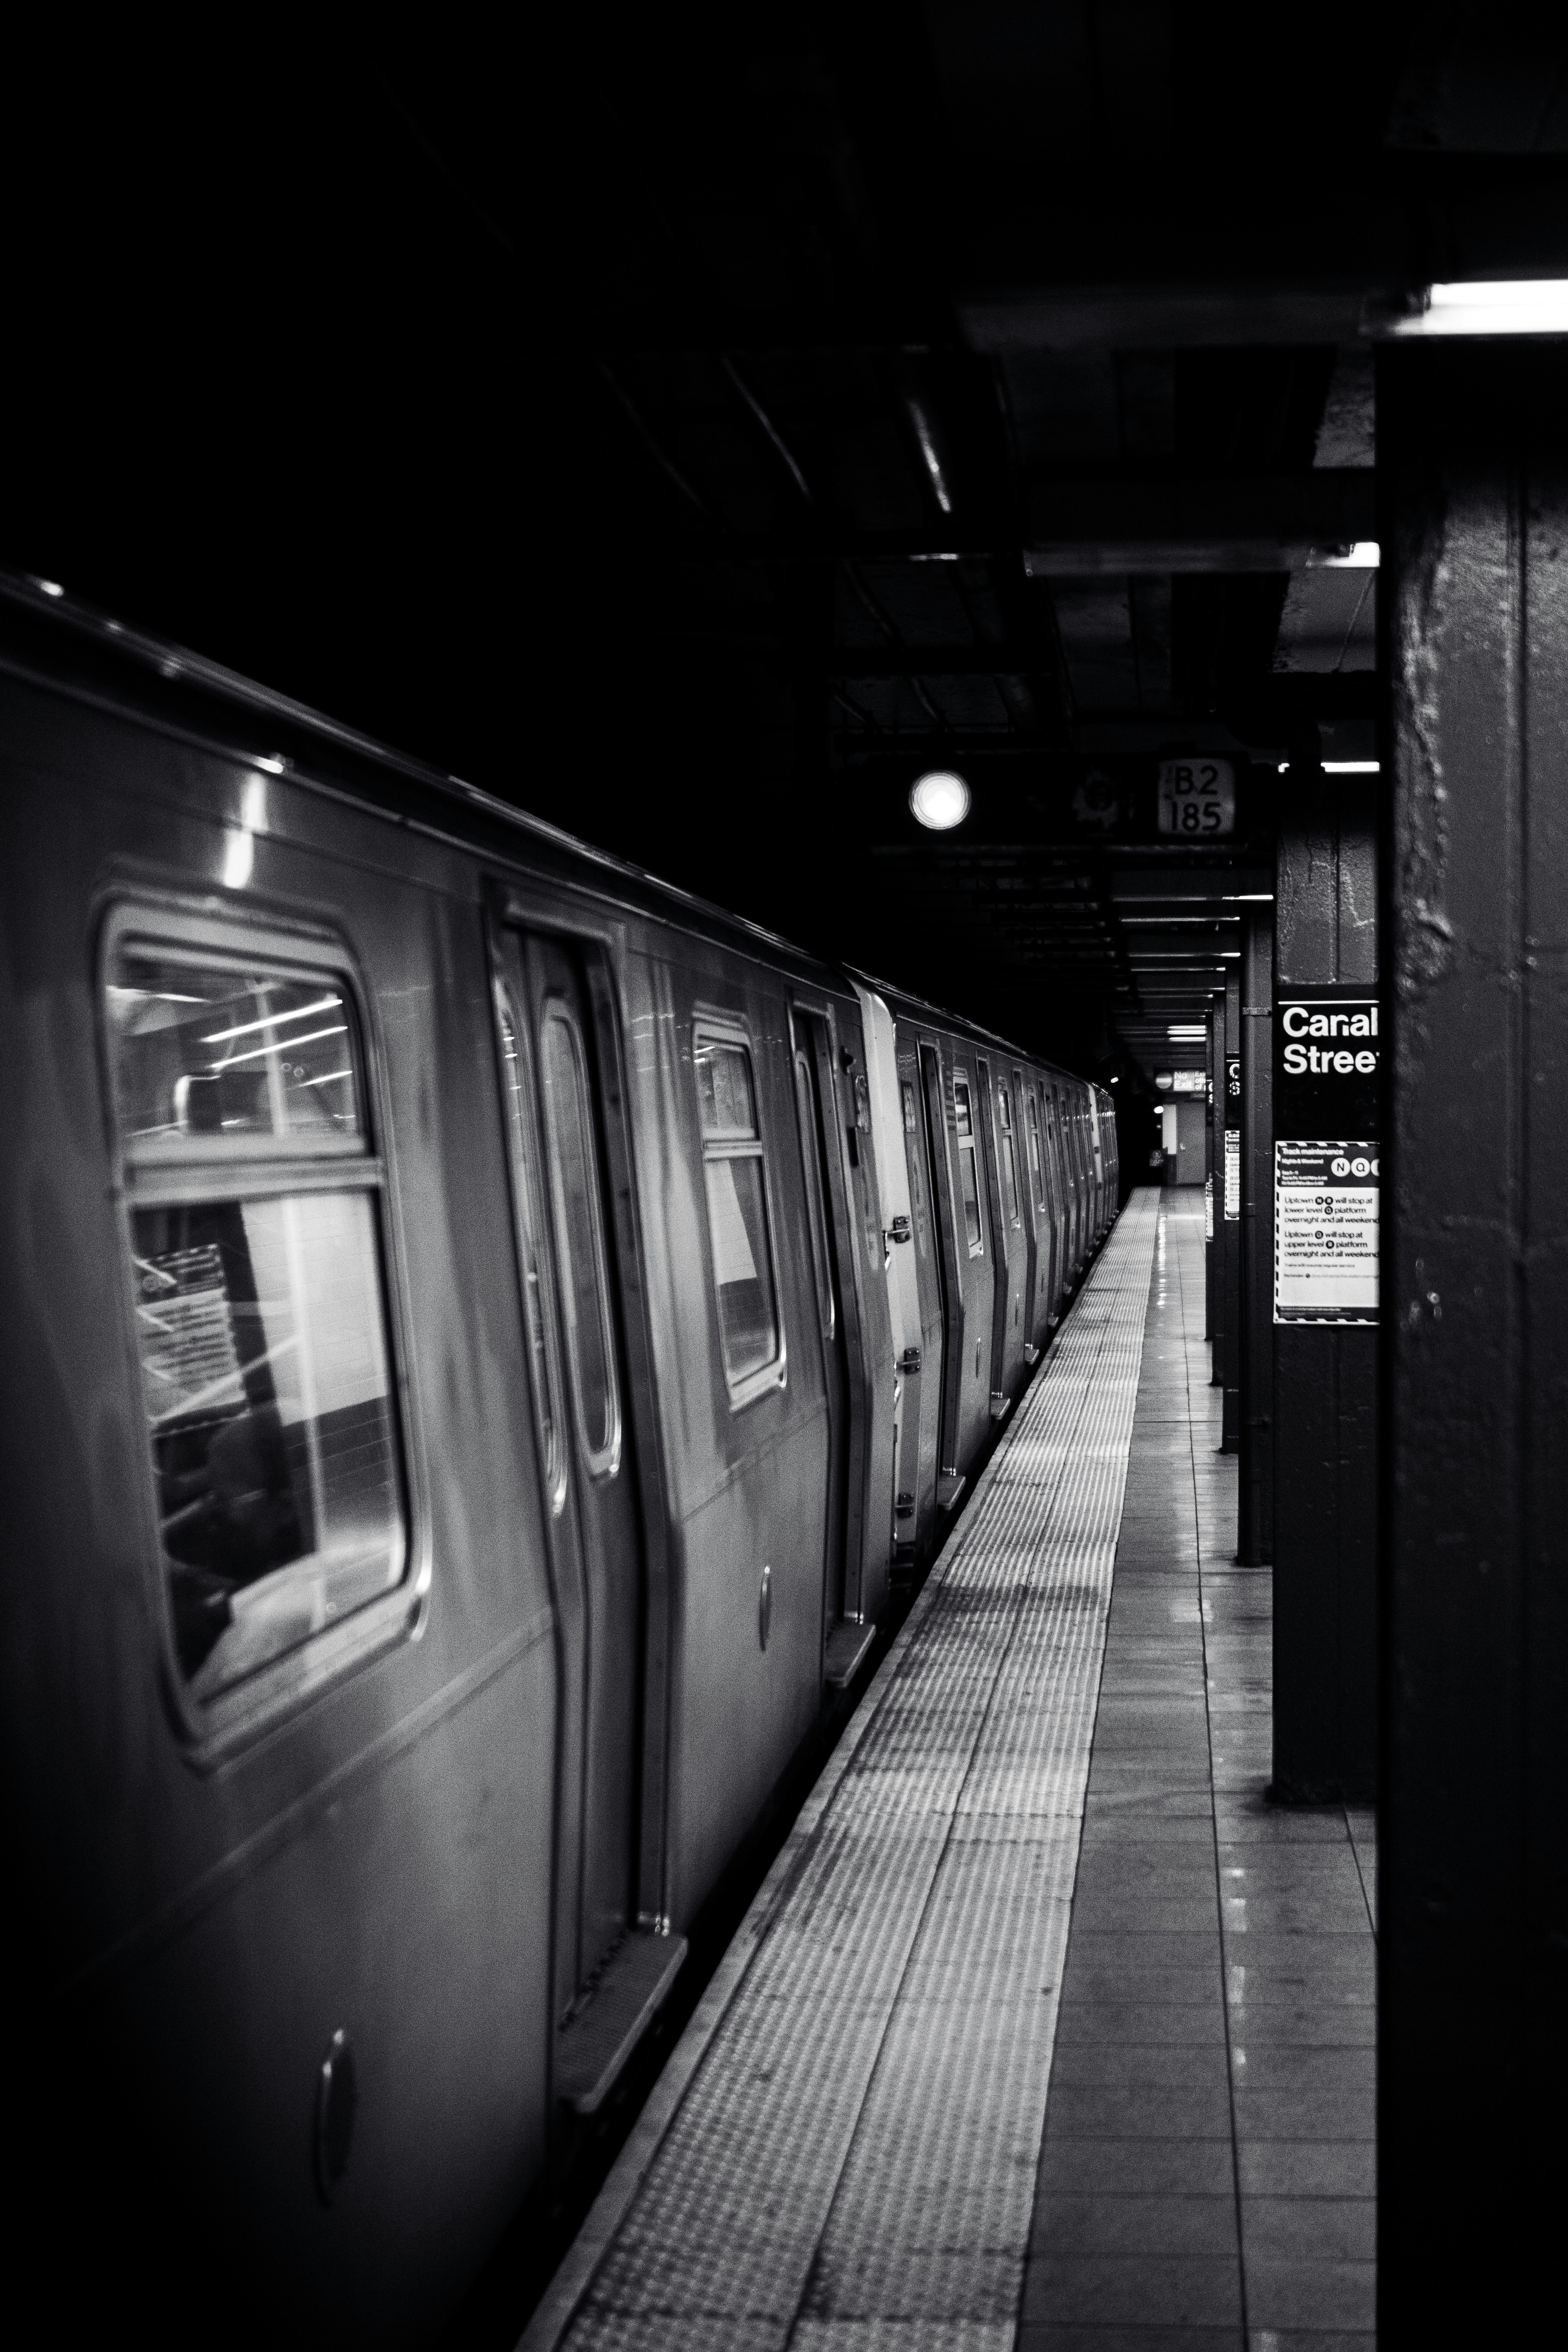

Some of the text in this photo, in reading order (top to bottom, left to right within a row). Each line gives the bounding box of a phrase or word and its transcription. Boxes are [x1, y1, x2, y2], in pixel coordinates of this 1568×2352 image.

[1176, 765, 1218, 795] B2
[1172, 802, 1221, 831] 185
[1283, 1007, 1378, 1037] Canal
[1283, 1044, 1379, 1074] Stree
